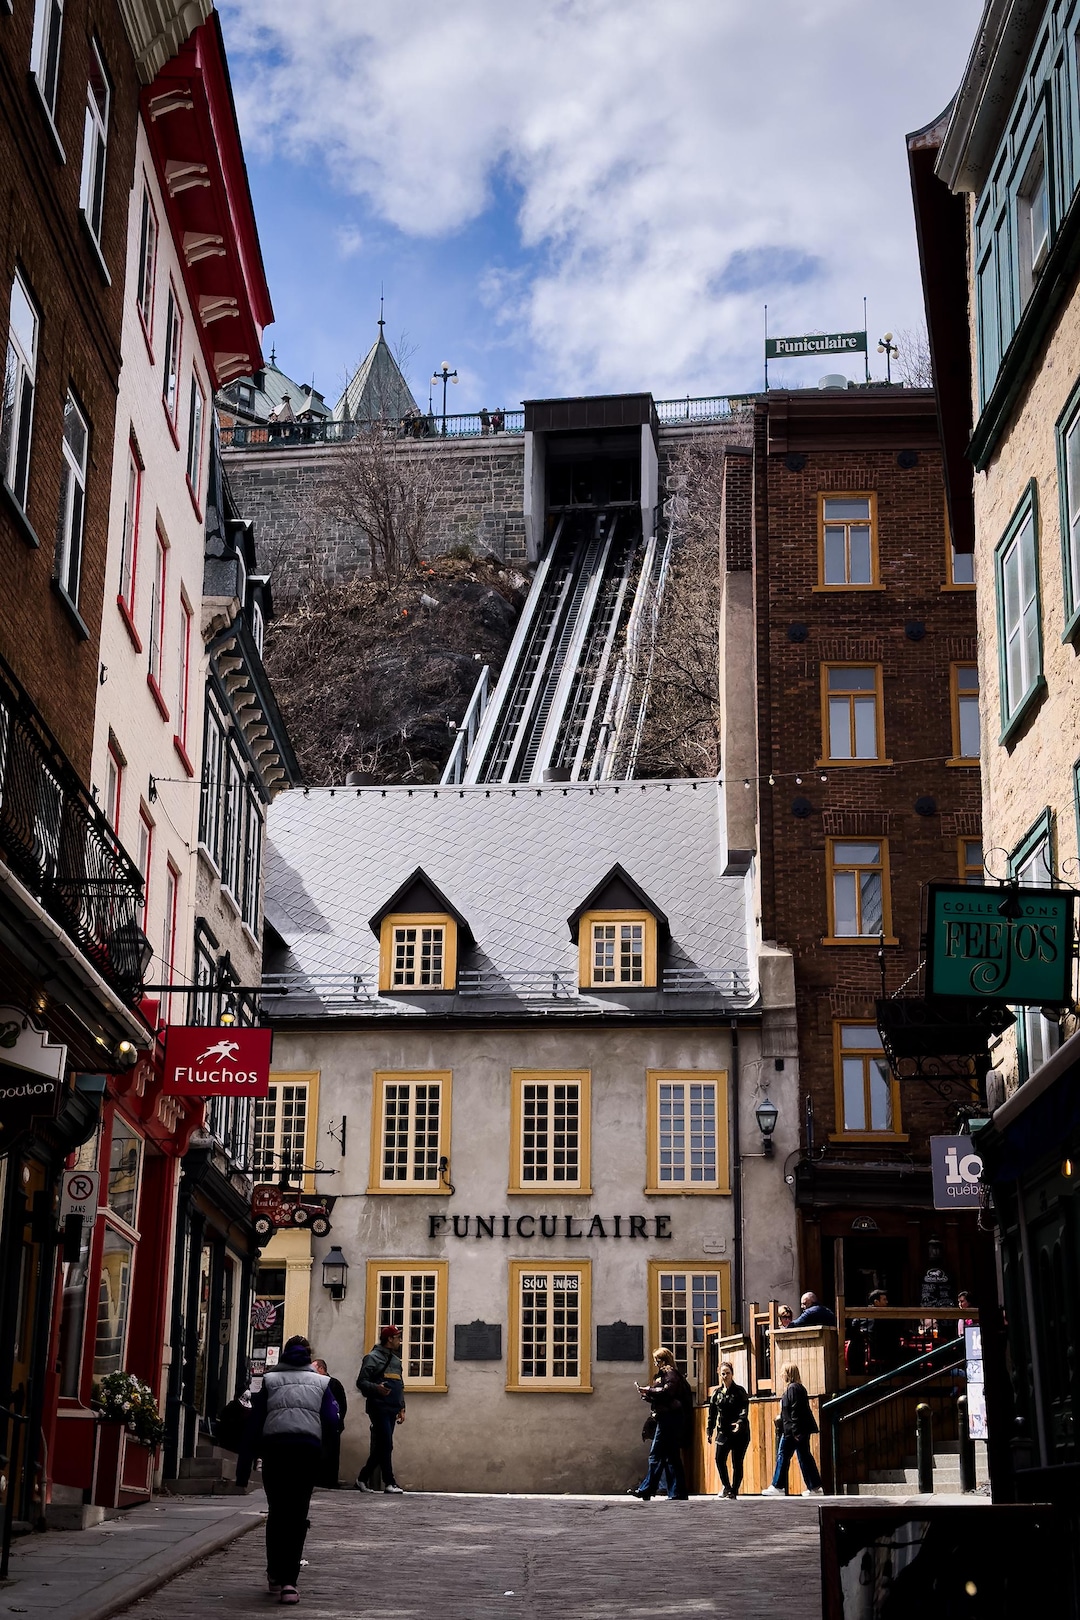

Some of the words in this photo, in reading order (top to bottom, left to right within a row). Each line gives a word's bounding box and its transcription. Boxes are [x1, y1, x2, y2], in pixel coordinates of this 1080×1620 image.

[775, 335, 857, 353] Funiculaire
[943, 902, 1058, 916] COLLEONS
[174, 1066, 258, 1083] Fluchos
[70, 1205, 86, 1213] DANS
[428, 1214, 673, 1239] FUNICULAIRE
